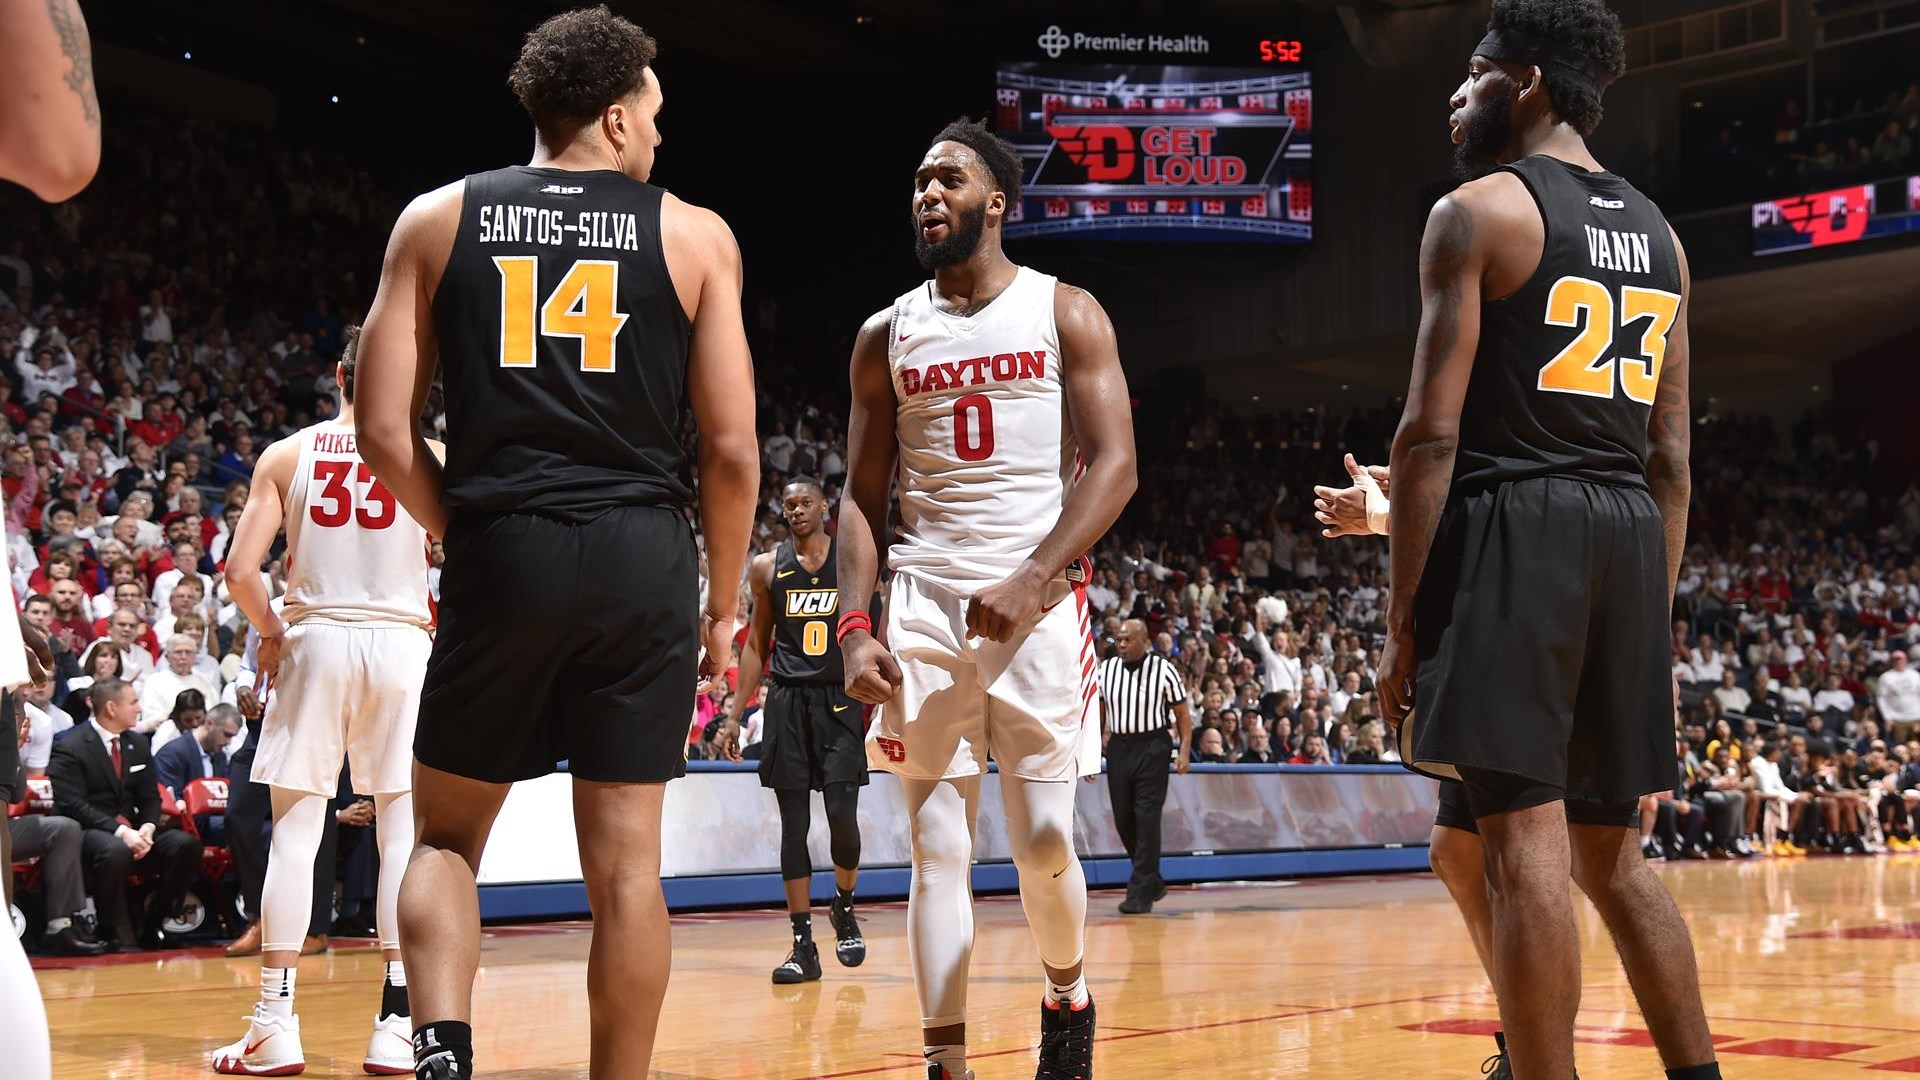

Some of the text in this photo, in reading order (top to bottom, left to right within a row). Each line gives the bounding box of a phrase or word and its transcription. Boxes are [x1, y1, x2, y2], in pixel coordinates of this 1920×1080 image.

[1073, 33, 1210, 53] Premier Health
[1259, 40, 1303, 62] 5:52
[1140, 125, 1217, 156] GET
[1144, 155, 1247, 185] LOUD
[479, 204, 639, 251] SANTOS-SILVA
[1584, 224, 1651, 274] VANN
[491, 255, 631, 373] 14
[1537, 275, 1682, 406] 23
[901, 350, 1046, 397] DAYTON
[953, 393, 995, 462] 0
[310, 460, 396, 530] 33
[788, 591, 839, 615] VCU
[802, 620, 829, 656] 0
